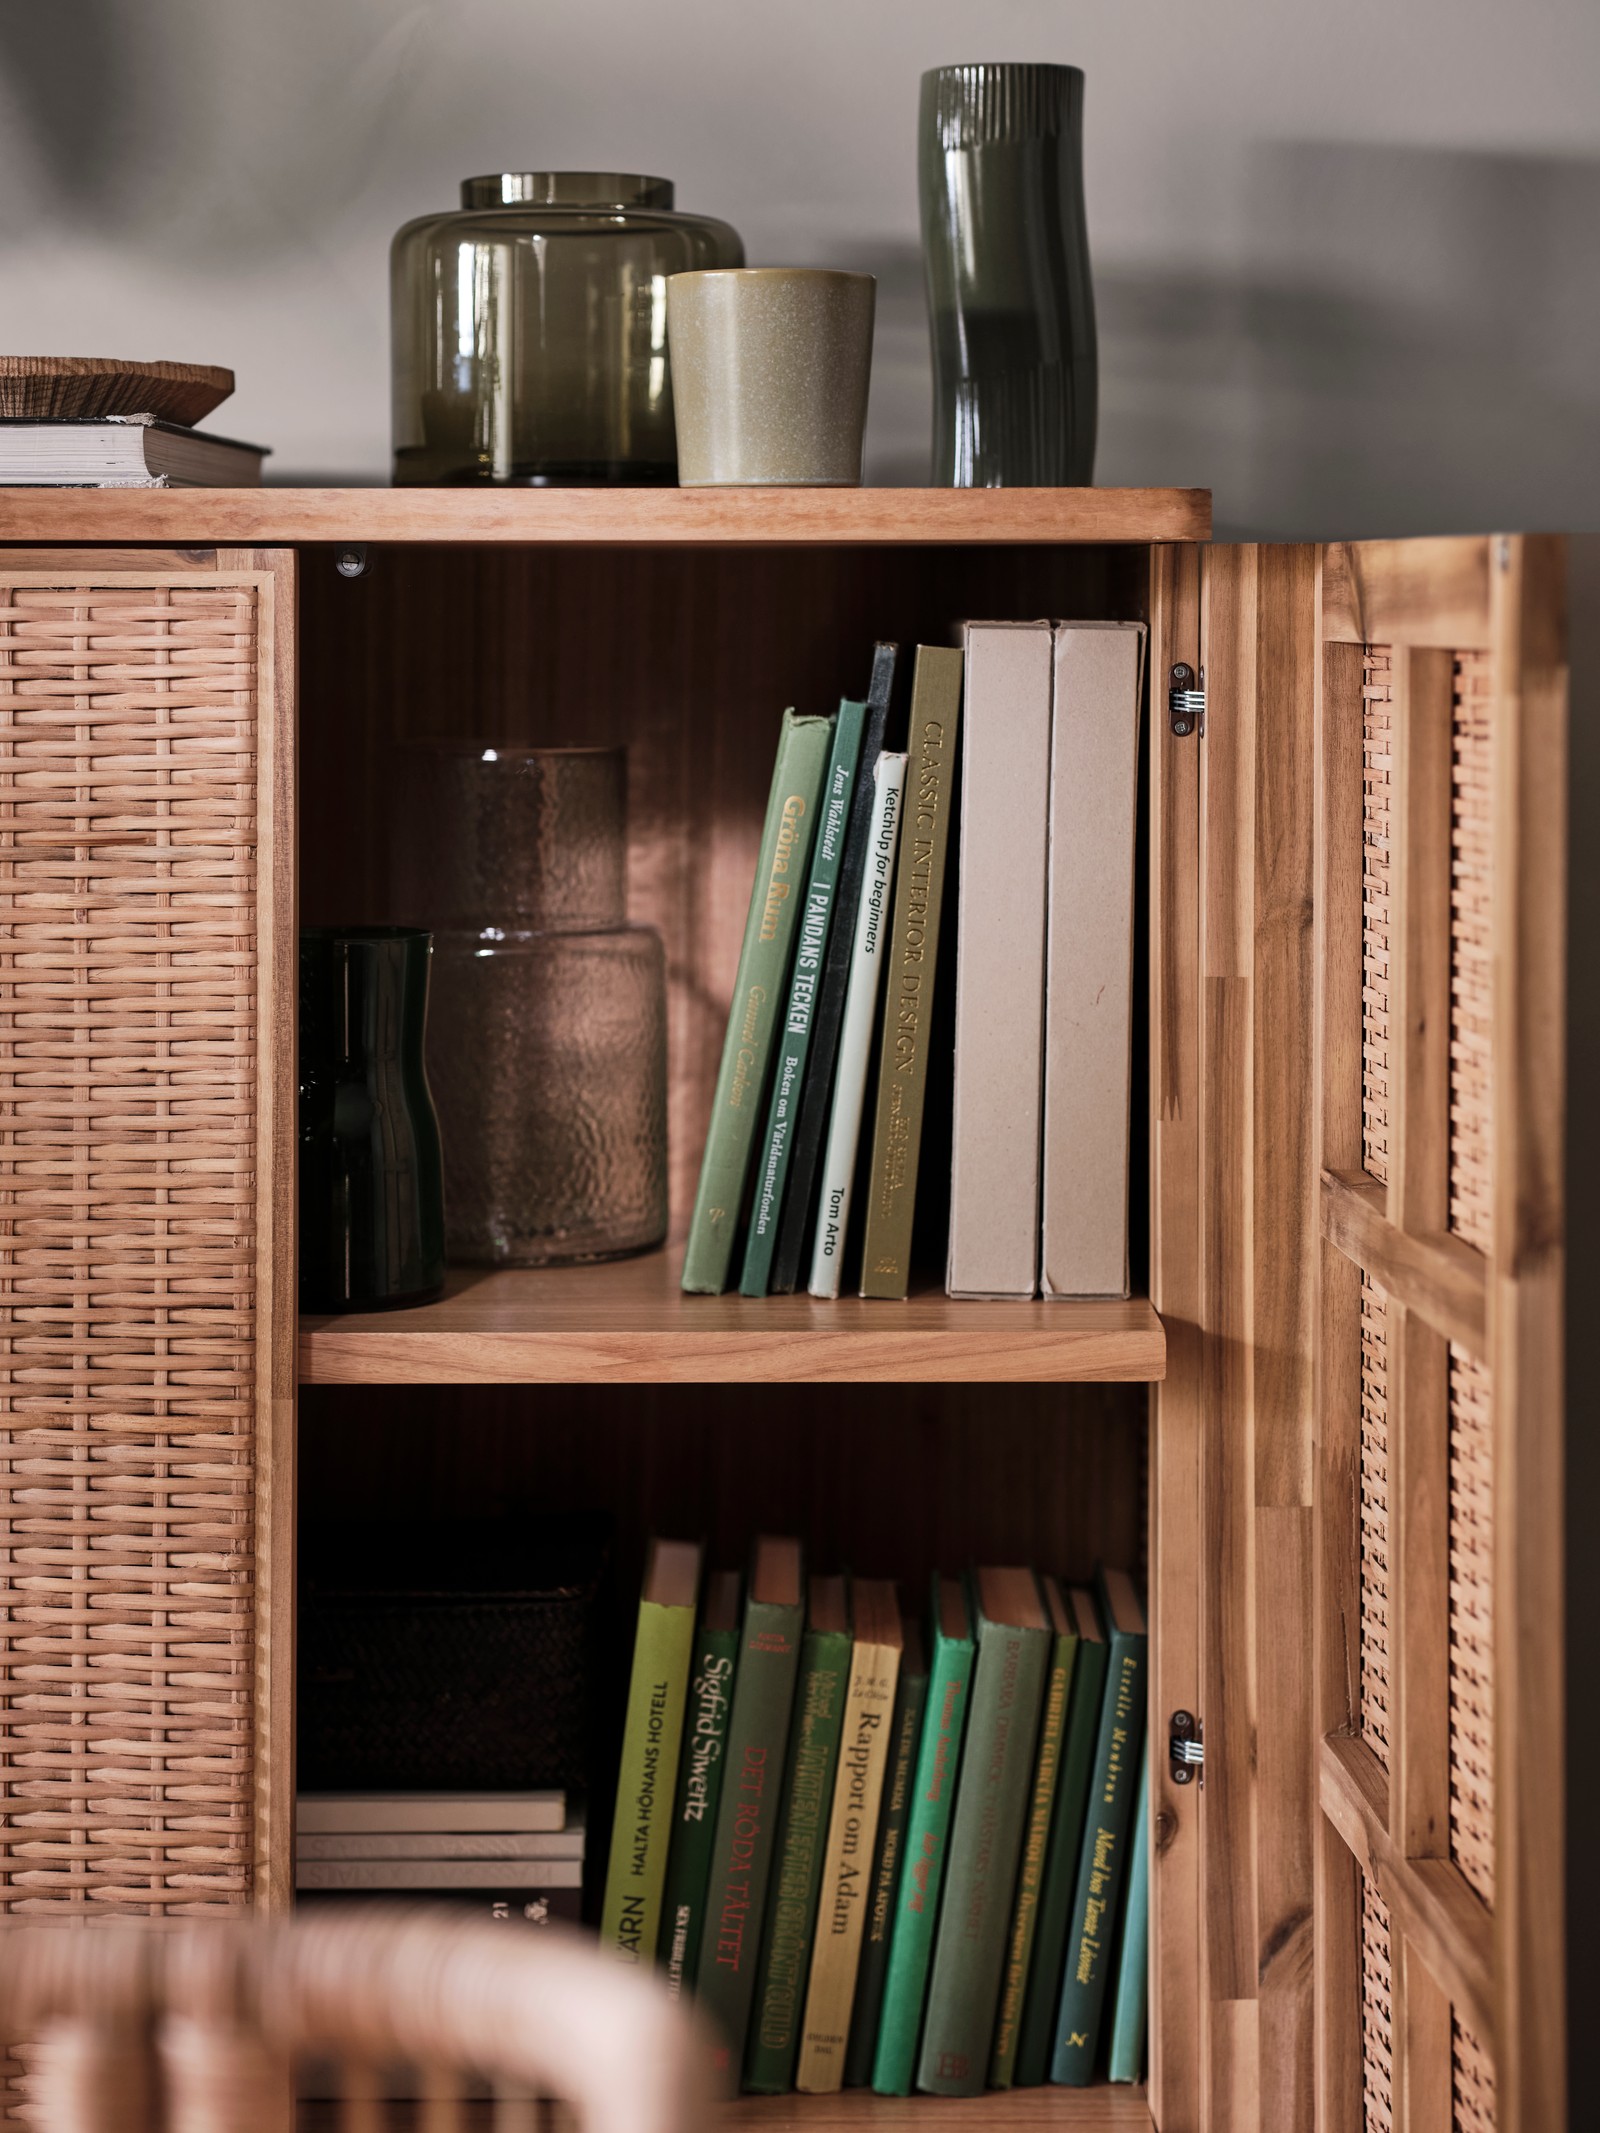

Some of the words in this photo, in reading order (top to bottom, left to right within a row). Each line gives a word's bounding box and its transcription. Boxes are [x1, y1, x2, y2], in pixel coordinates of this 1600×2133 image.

[833, 764, 849, 796] Jens
[917, 721, 944, 829] CLASSIC
[771, 795, 805, 873] Gröna
[822, 800, 844, 860] Wahlstedt
[877, 788, 899, 850] KetchUp
[875, 852, 890, 877] for
[759, 880, 790, 942] Rum
[799, 893, 829, 969] PANDANS
[865, 880, 886, 953] beginners
[904, 839, 932, 965] INTERIOR
[742, 985, 767, 1046] Gunnel
[787, 971, 815, 1034] TECKEN
[895, 976, 921, 1075] DESIGN
[777, 1099, 787, 1117] om
[781, 1056, 798, 1095] Boken
[757, 1121, 787, 1234] Världsnaturfonden
[829, 1188, 844, 1218] Tom
[824, 1223, 839, 1256] Arto
[693, 1654, 732, 1735] Sigfrid
[941, 1681, 961, 1730] Thomas
[999, 1640, 1020, 1709] BARBARA
[1044, 1666, 1066, 1741] GABRIEL
[1116, 1657, 1137, 1718] Estelle
[647, 1682, 668, 1743] HOTELL
[638, 1748, 659, 1821] HÖNANS
[684, 1736, 721, 1821] Siwertz
[740, 1747, 766, 1796] DET
[790, 1736, 828, 1828] JAKTEN
[846, 1711, 880, 1811] Rapport
[1035, 1741, 1056, 1806] GARCÍA
[1104, 1728, 1126, 1803] Monbrun
[631, 1825, 649, 1876] HALTA
[729, 1803, 760, 1872] RÖDA
[779, 1829, 815, 1899] EFTER
[842, 1818, 861, 1854] om
[1093, 1828, 1115, 1871] Mord
[716, 1881, 750, 1971] TÄLTET
[832, 1862, 860, 1934] Adam
[769, 1901, 806, 1985] GRÖNT
[760, 1984, 795, 2050] GULD
